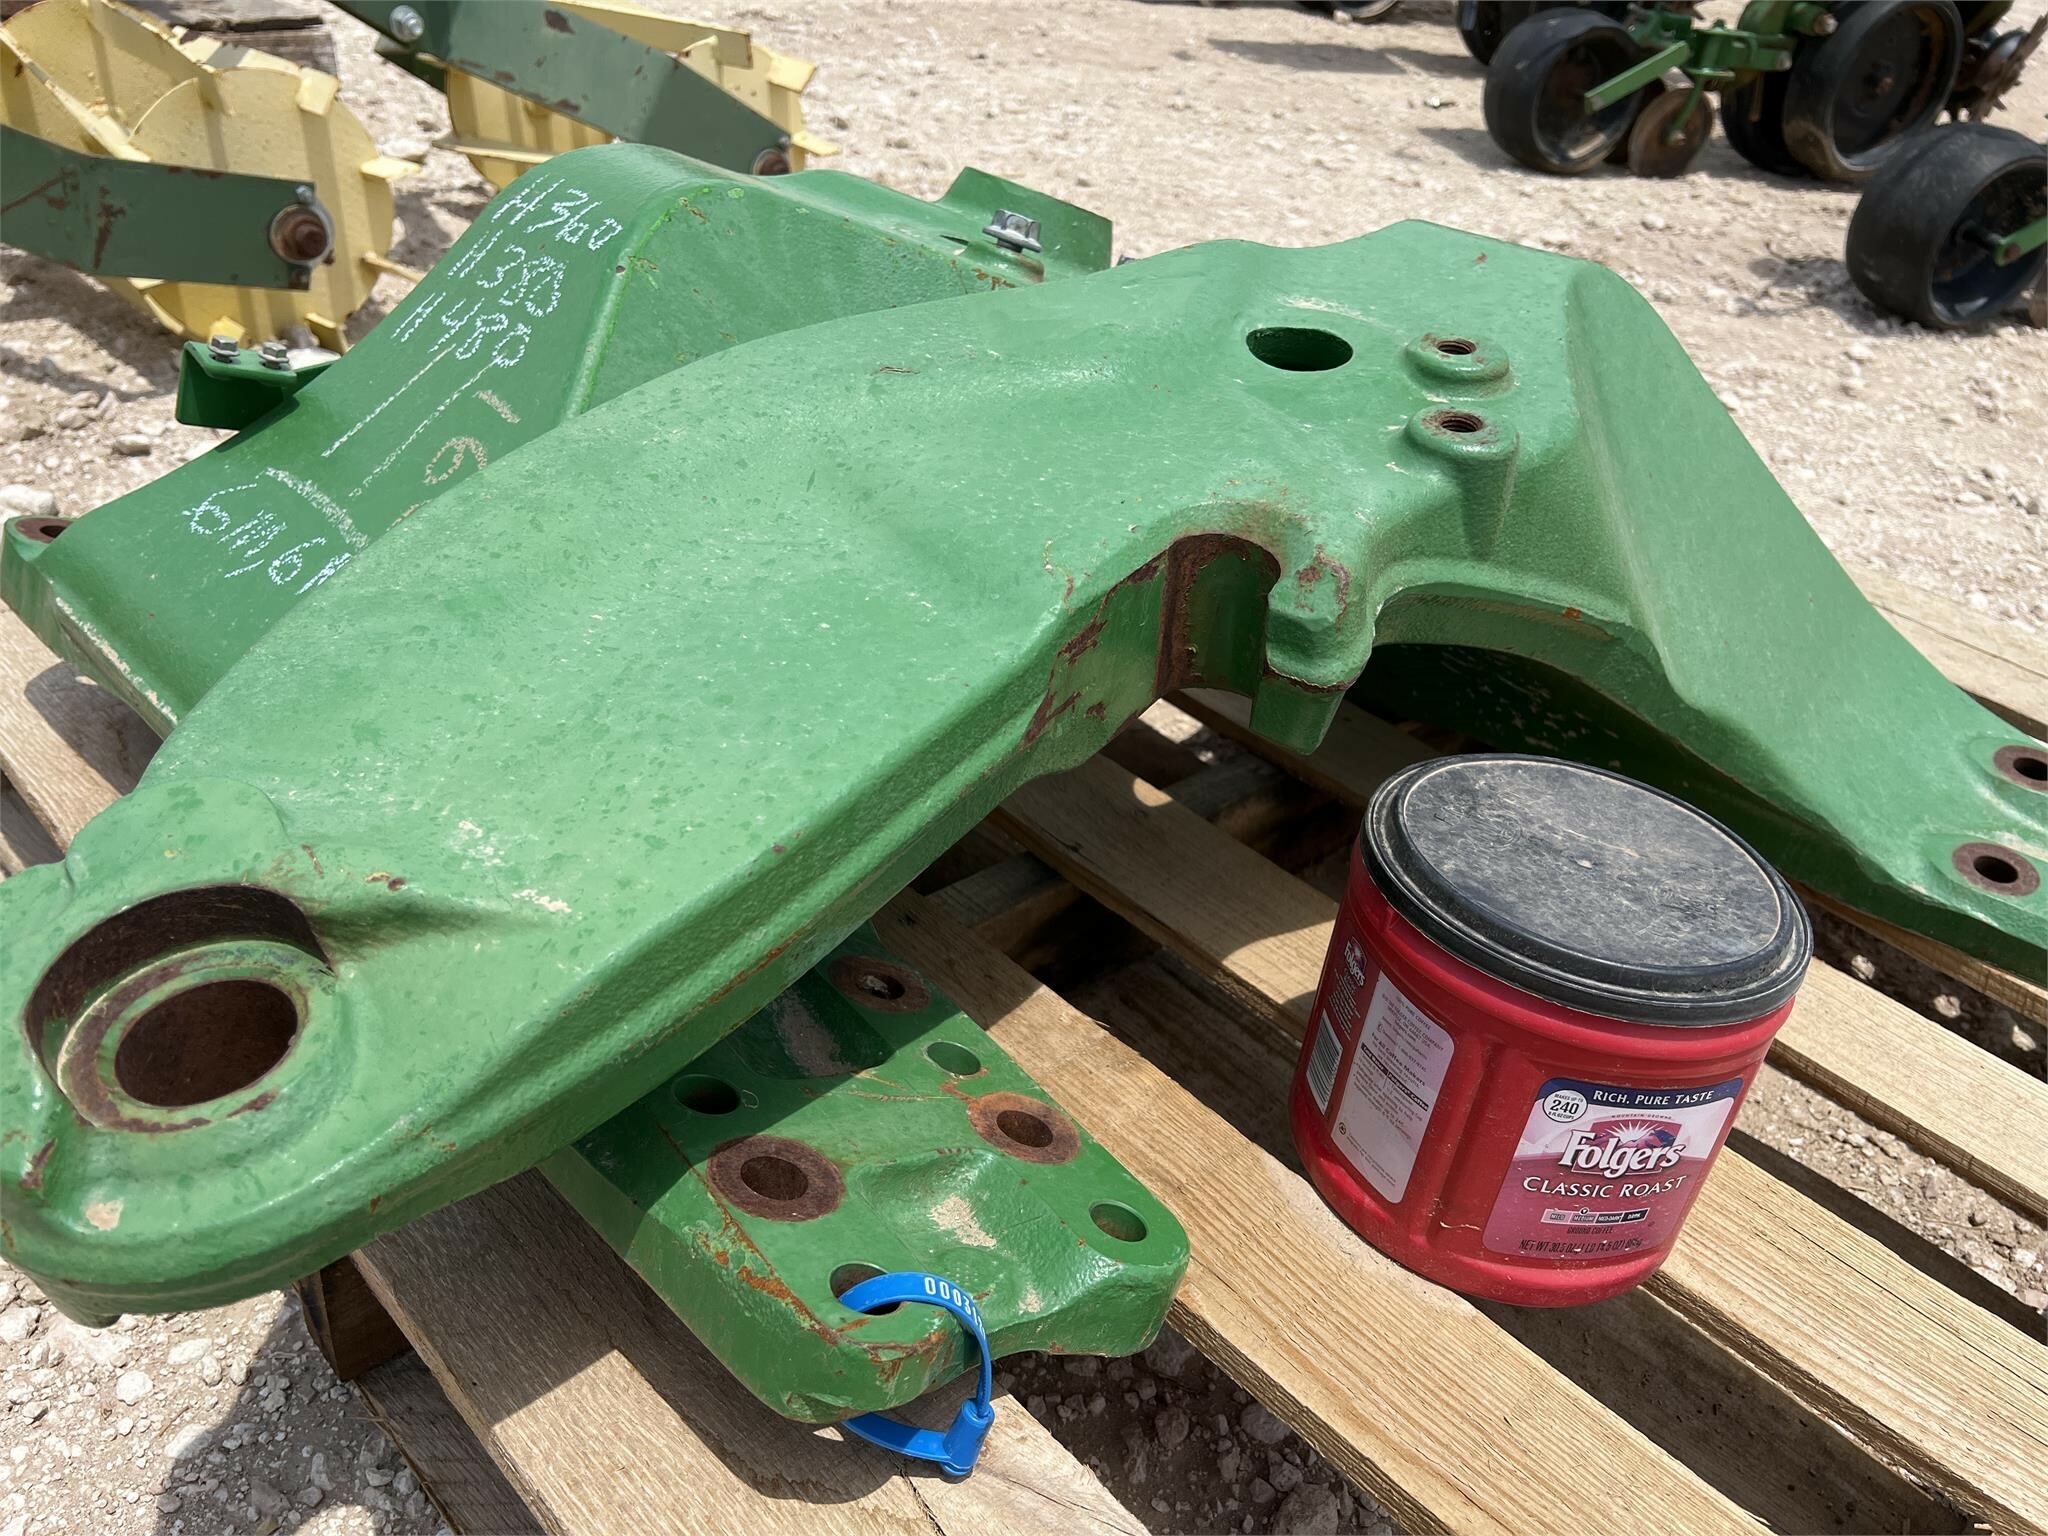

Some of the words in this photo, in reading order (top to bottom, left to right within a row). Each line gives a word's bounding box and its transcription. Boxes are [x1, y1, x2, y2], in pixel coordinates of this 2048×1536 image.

[491, 173, 623, 251] H360
[447, 230, 569, 318] H380
[391, 292, 532, 368] H480
[1550, 1099, 1580, 1115] 240
[1635, 1094, 1671, 1105] PURE
[1674, 1090, 1715, 1105] TASTE
[1558, 1130, 1686, 1178] Folgers
[1522, 1176, 1614, 1198] CLASSIC
[1619, 1175, 1687, 1198] ROAST
[1519, 1240, 1535, 1250] NET
[1536, 1241, 1549, 1251] WT
